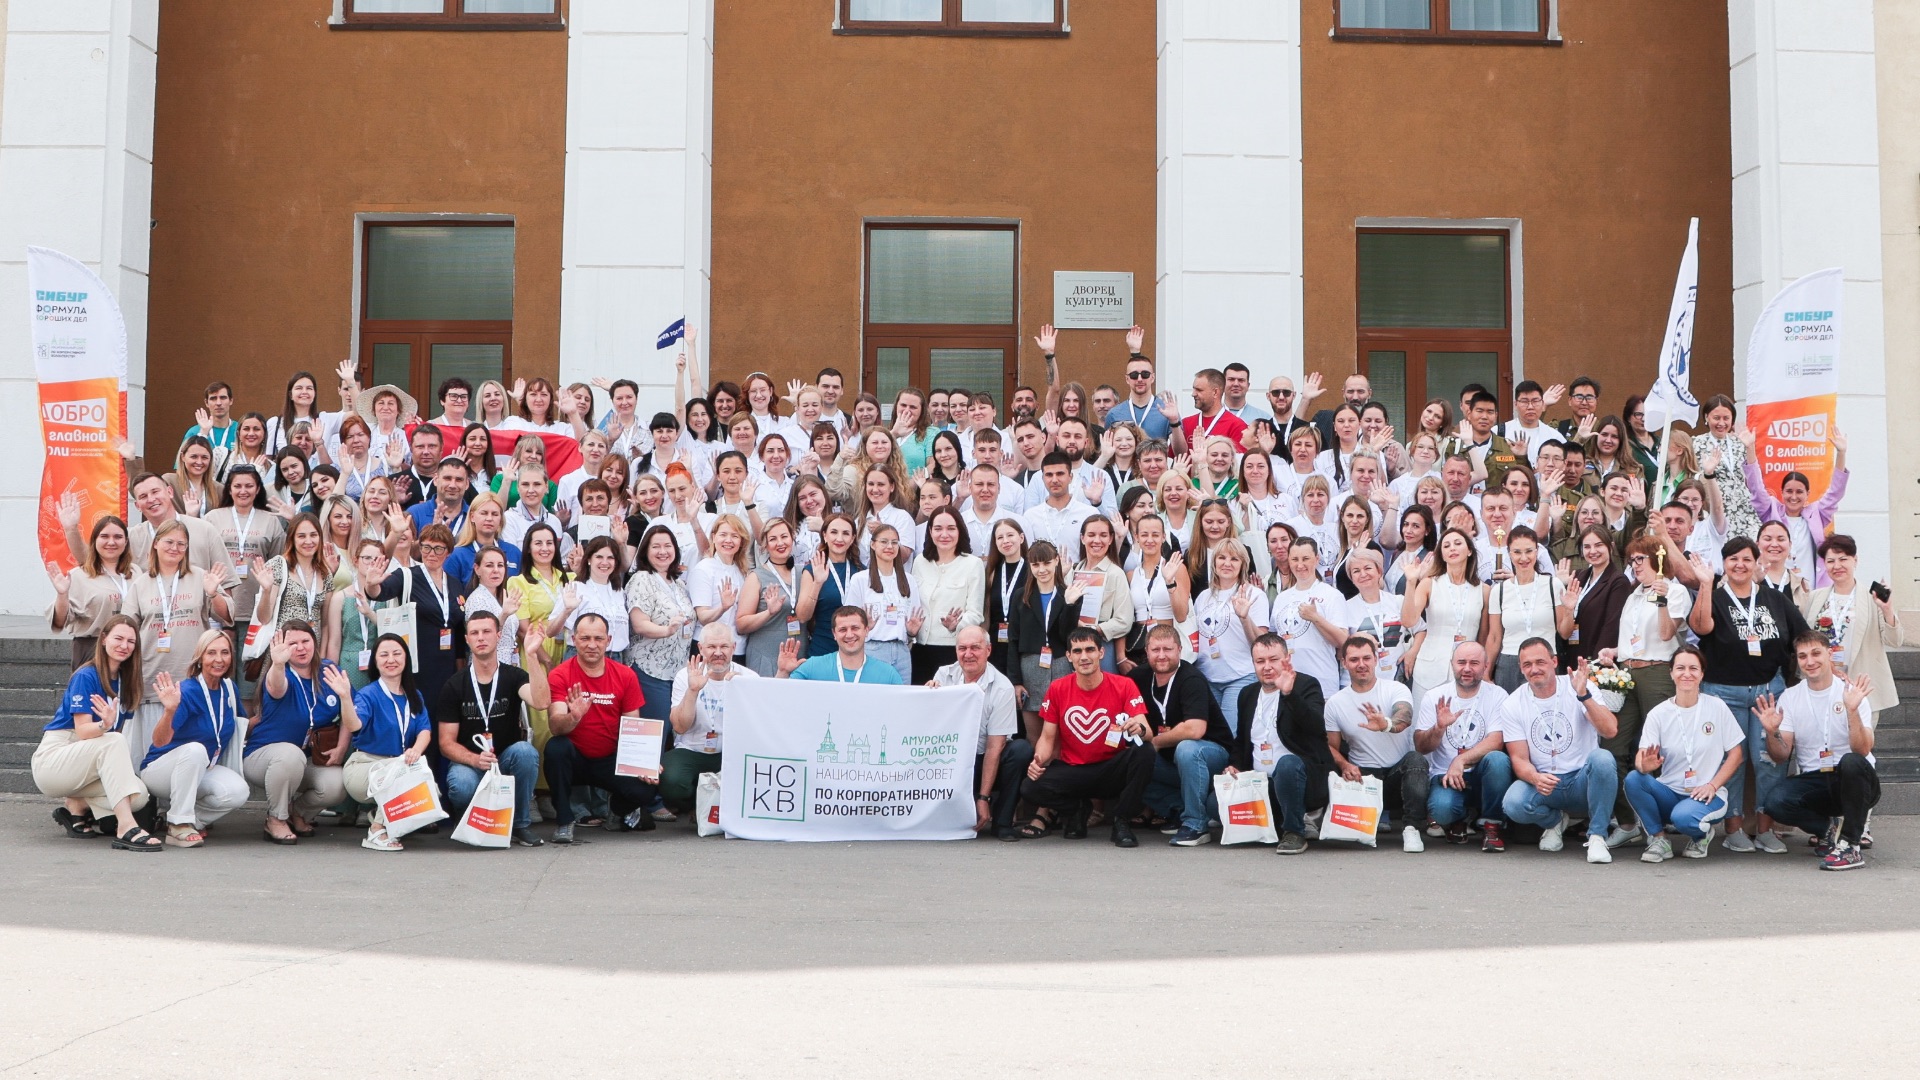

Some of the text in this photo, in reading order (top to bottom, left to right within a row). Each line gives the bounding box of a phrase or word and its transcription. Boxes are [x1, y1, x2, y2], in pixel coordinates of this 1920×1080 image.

[36, 290, 88, 302] СИБУР
[1072, 286, 1116, 296] ДВОРЕЦ
[1065, 298, 1122, 307] КУЛЬТУРЫ
[36, 304, 87, 314] ФОРМУЛА
[1784, 311, 1833, 322] СИБУР
[1784, 325, 1833, 333] ФОРМУЛА
[1768, 420, 1825, 437] ДОБРО
[49, 429, 107, 442] главной
[48, 446, 69, 456] оли
[1766, 444, 1826, 457] в главной
[1766, 463, 1794, 474] роли
[902, 733, 959, 746] АМУРСКАЯ
[910, 745, 957, 757] ОБЛАСТЬ
[754, 762, 796, 788] НС
[816, 768, 954, 782] НАЦИОНАЛЬНЫЙ СОВЕТ
[815, 788, 953, 801] ПО КОРПОРАТИВНОМУ
[753, 789, 795, 813] КВ
[814, 804, 913, 816] ВОЛОНТЕРСТВУ
